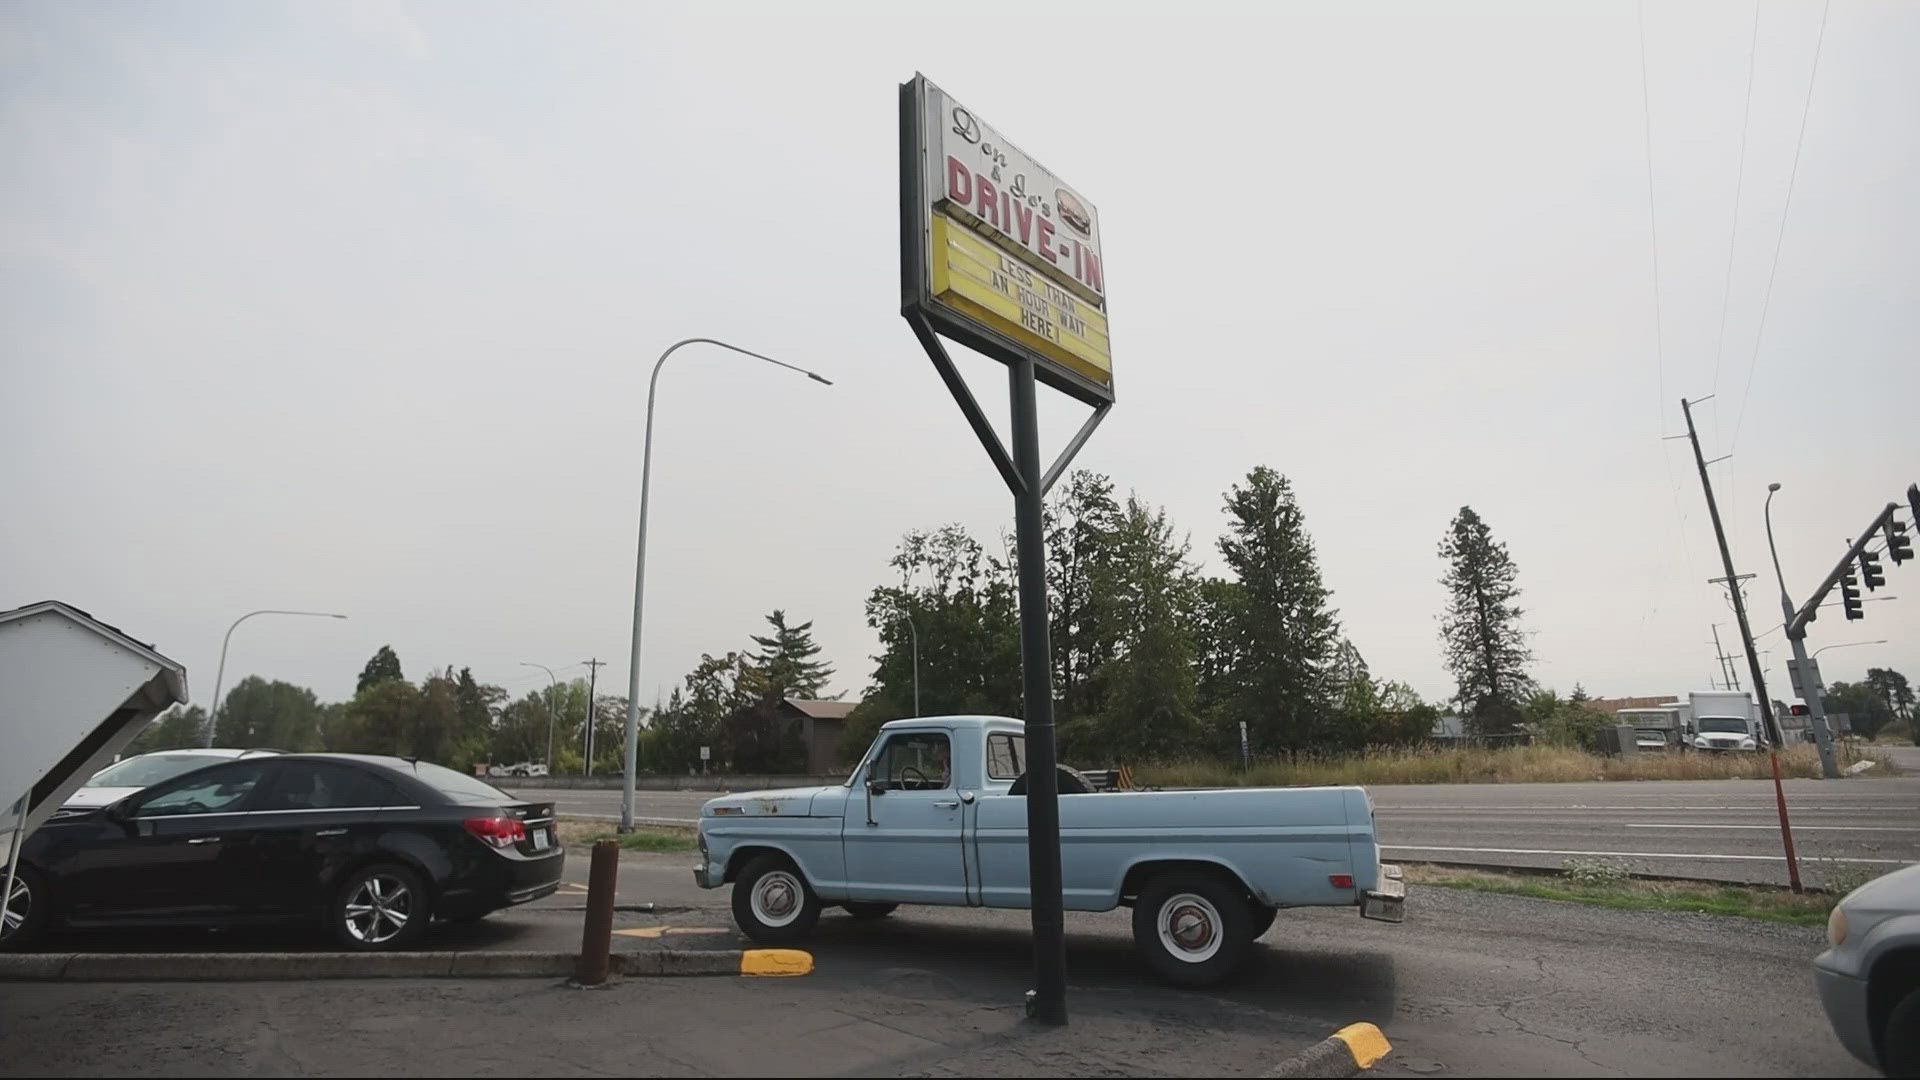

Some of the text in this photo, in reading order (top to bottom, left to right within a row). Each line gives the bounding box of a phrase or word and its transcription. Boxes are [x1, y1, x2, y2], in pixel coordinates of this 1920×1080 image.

[952, 107, 1007, 167] Don
[991, 165, 1001, 183] &
[948, 155, 1101, 293] DRIVE-IN
[992, 270, 1085, 339] AN HOUR WAIT
[1000, 255, 1075, 313] LESS THAN
